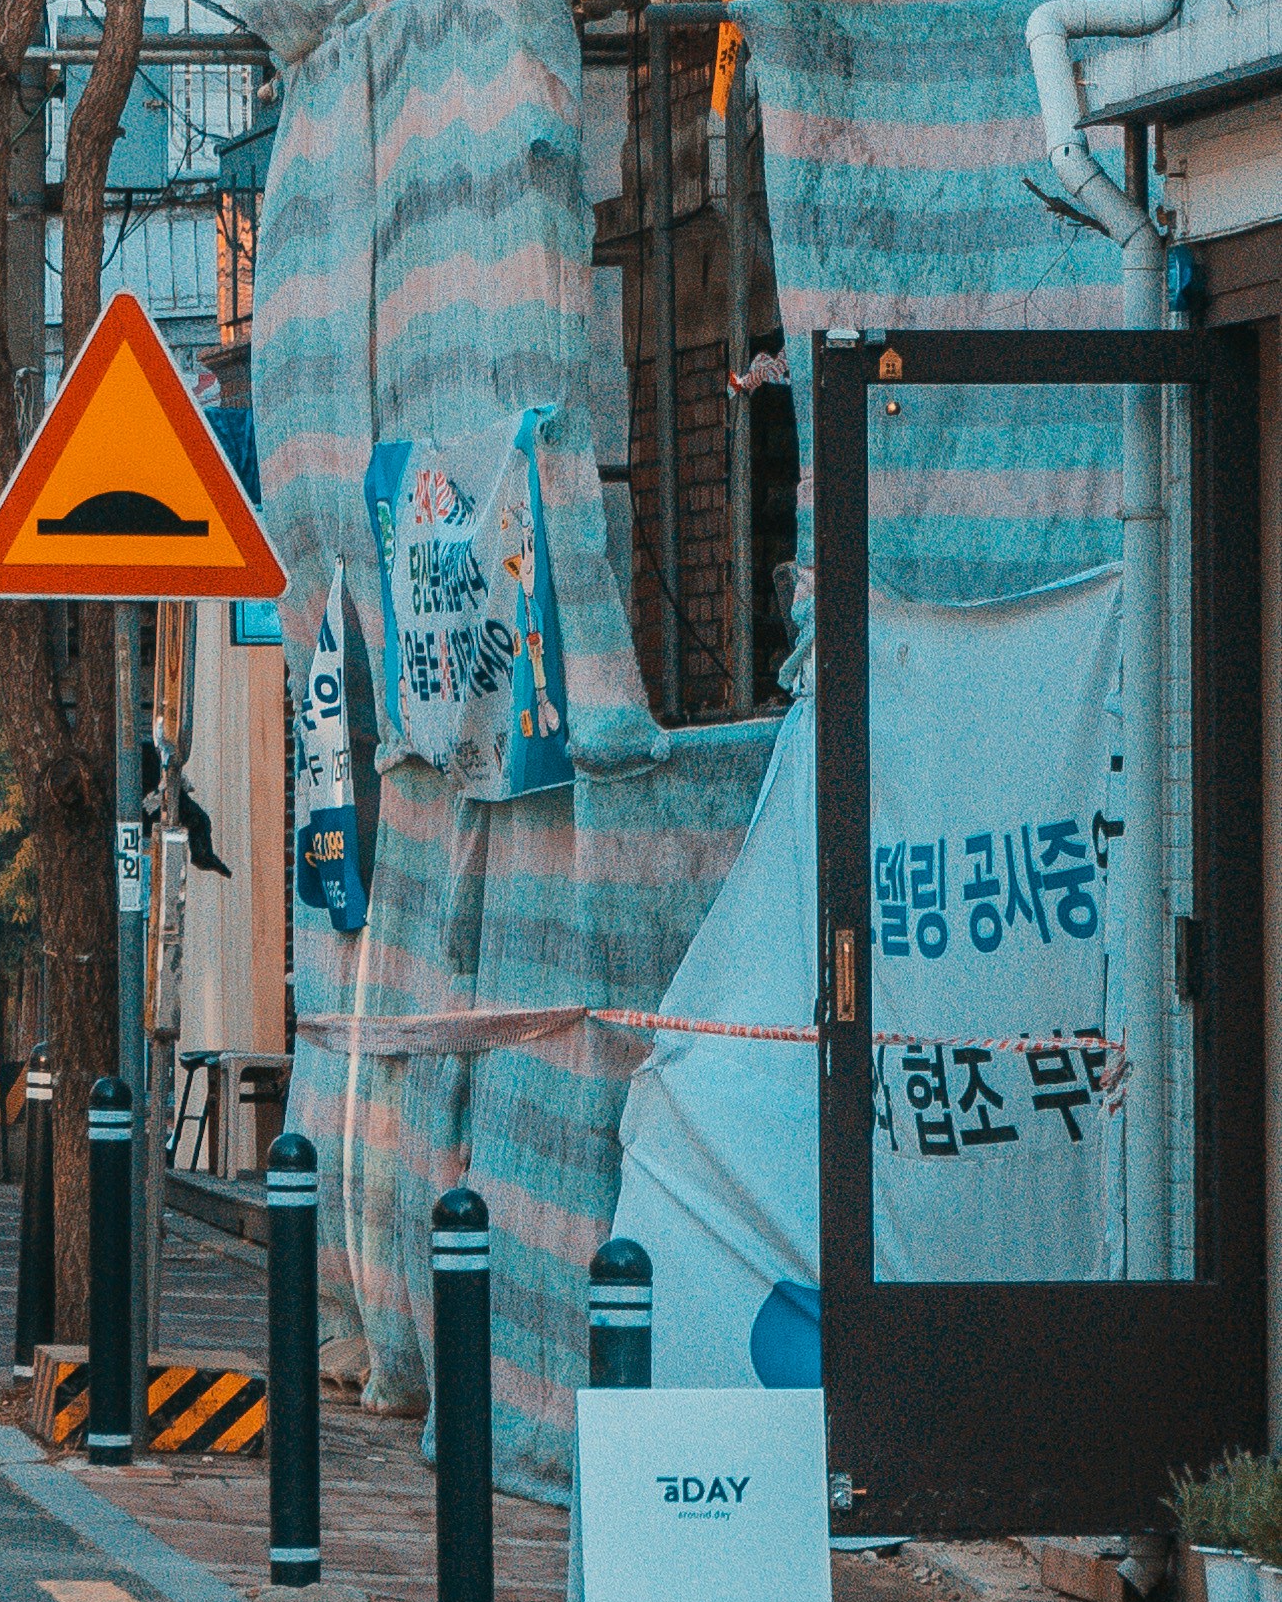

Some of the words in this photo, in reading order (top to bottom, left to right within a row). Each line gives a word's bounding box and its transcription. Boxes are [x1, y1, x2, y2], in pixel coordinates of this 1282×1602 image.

[121, 826, 140, 881] 과외
[872, 836, 949, 960] 델링
[962, 819, 1099, 953] 공사중
[902, 1044, 1020, 1156] 협조
